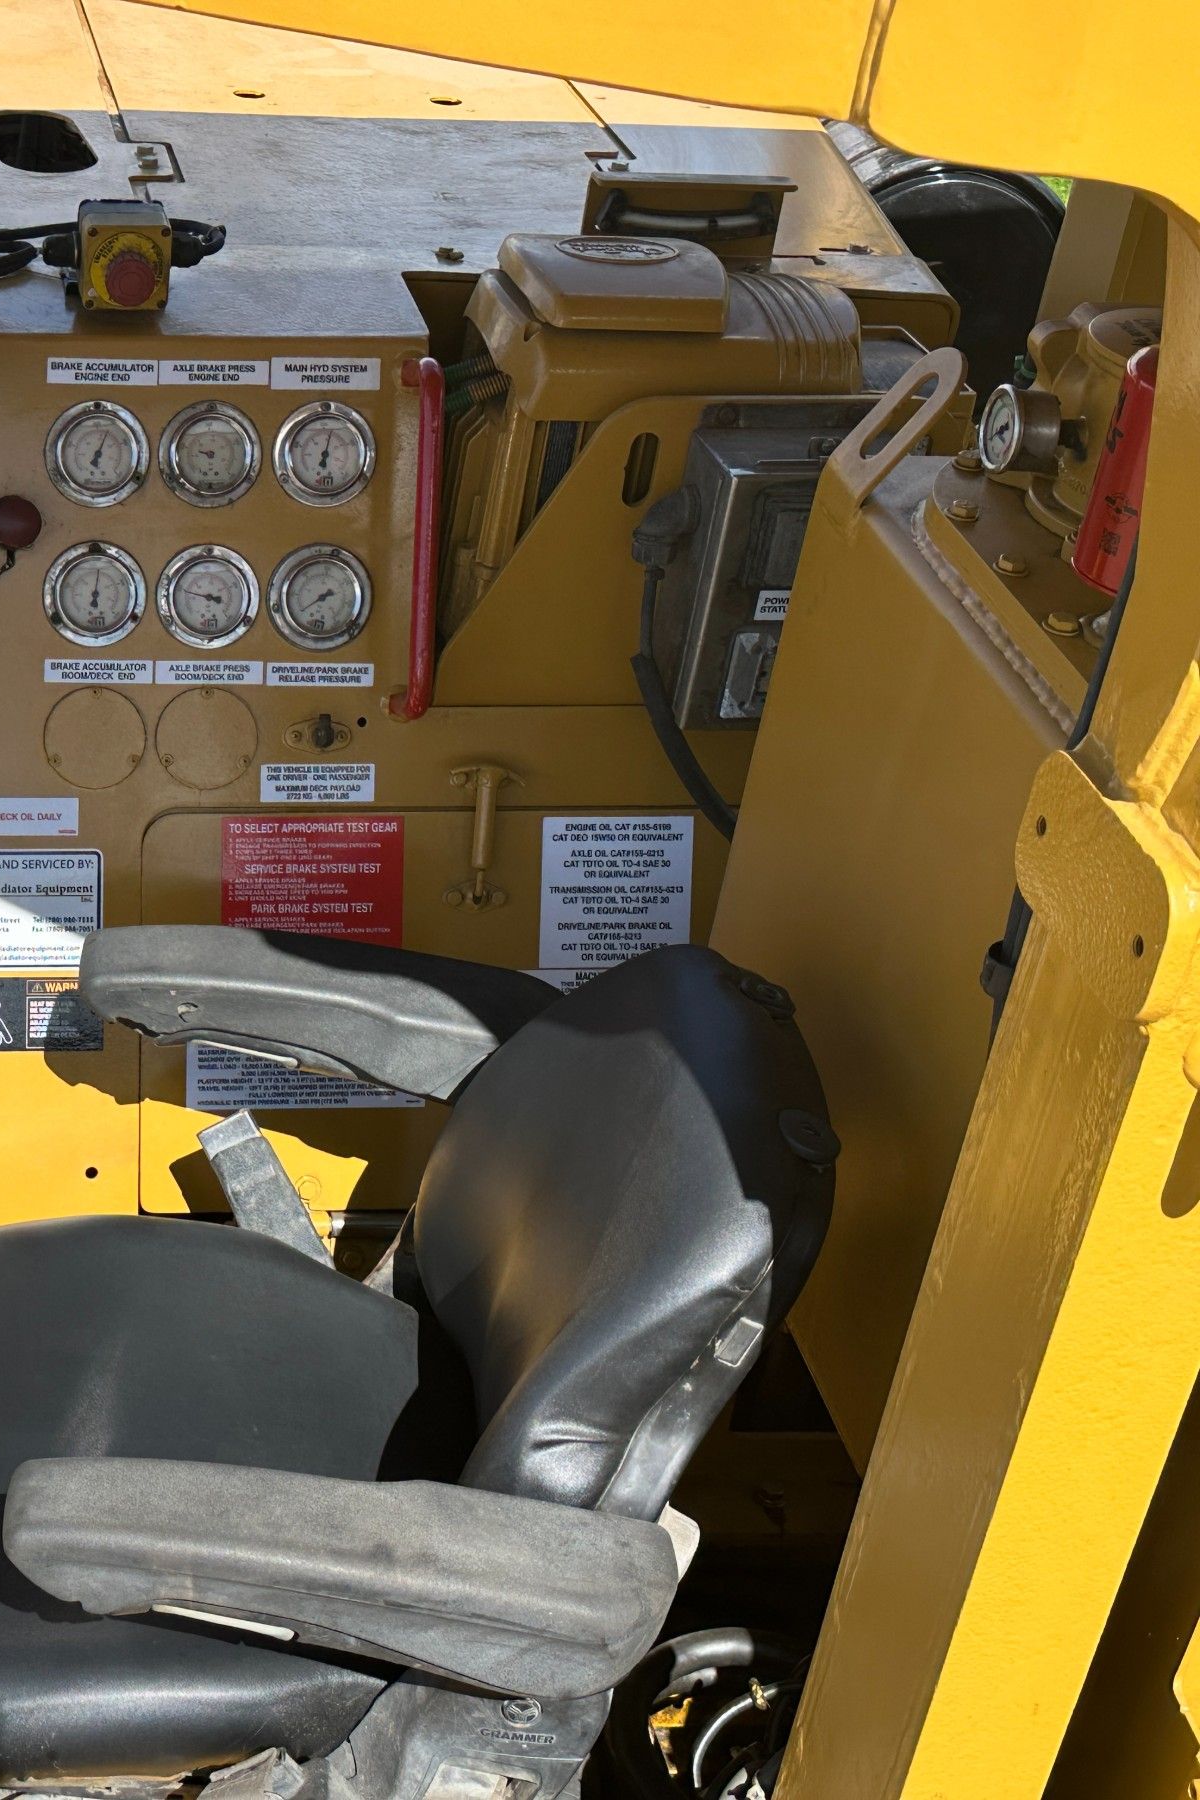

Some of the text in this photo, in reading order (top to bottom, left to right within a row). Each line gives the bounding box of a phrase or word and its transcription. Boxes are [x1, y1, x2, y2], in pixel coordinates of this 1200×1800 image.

[50, 362, 154, 372] BRAKE ACCUMULATOR
[172, 364, 256, 372] AXLE BRAKE PRESS
[284, 364, 368, 373] MAIN HYD SYSTEM
[74, 372, 130, 382] ENGINE END
[188, 373, 240, 382] ENGINE END
[301, 374, 350, 384] PRESSURE
[760, 606, 786, 614] STAT
[50, 662, 147, 672] BRAKE ACCUMULATOR
[169, 664, 190, 672] AXLE
[192, 664, 221, 672] BRAKE
[272, 666, 339, 674] DRIVELINE/PARK
[62, 672, 136, 680] BOOM/DECK END
[279, 674, 361, 683] RELEASE PRESSURE
[229, 822, 397, 833] TO SELECT APPROPRIATE TEST GEAR
[552, 834, 567, 842] CAT
[570, 834, 588, 842] DEO
[618, 834, 630, 842] OR
[571, 850, 592, 858] AXLE
[595, 850, 608, 858] OIL
[22, 860, 75, 870] SERVICED
[78, 860, 94, 870] BY:
[244, 863, 381, 874] SERVICE BRAKE SYSTEM TEST
[563, 860, 579, 868] CAT
[606, 860, 619, 868] OIL
[622, 860, 641, 868] TO-4
[643, 860, 659, 868] SAE
[661, 860, 671, 868] 30
[584, 870, 650, 878] OR EQUIVALENT
[36, 884, 93, 896] Equipment
[252, 903, 373, 913] PARK BRAKE SYSTEM TEST
[557, 922, 672, 930] DRIVELINE/PARK BRAKE OIL
[561, 943, 577, 951] CAT
[603, 943, 617, 951] OIL
[620, 943, 638, 951] TO-4
[581, 953, 593, 961] OR
[45, 982, 79, 992] WARN
[479, 1728, 556, 1744] GRAMMER
